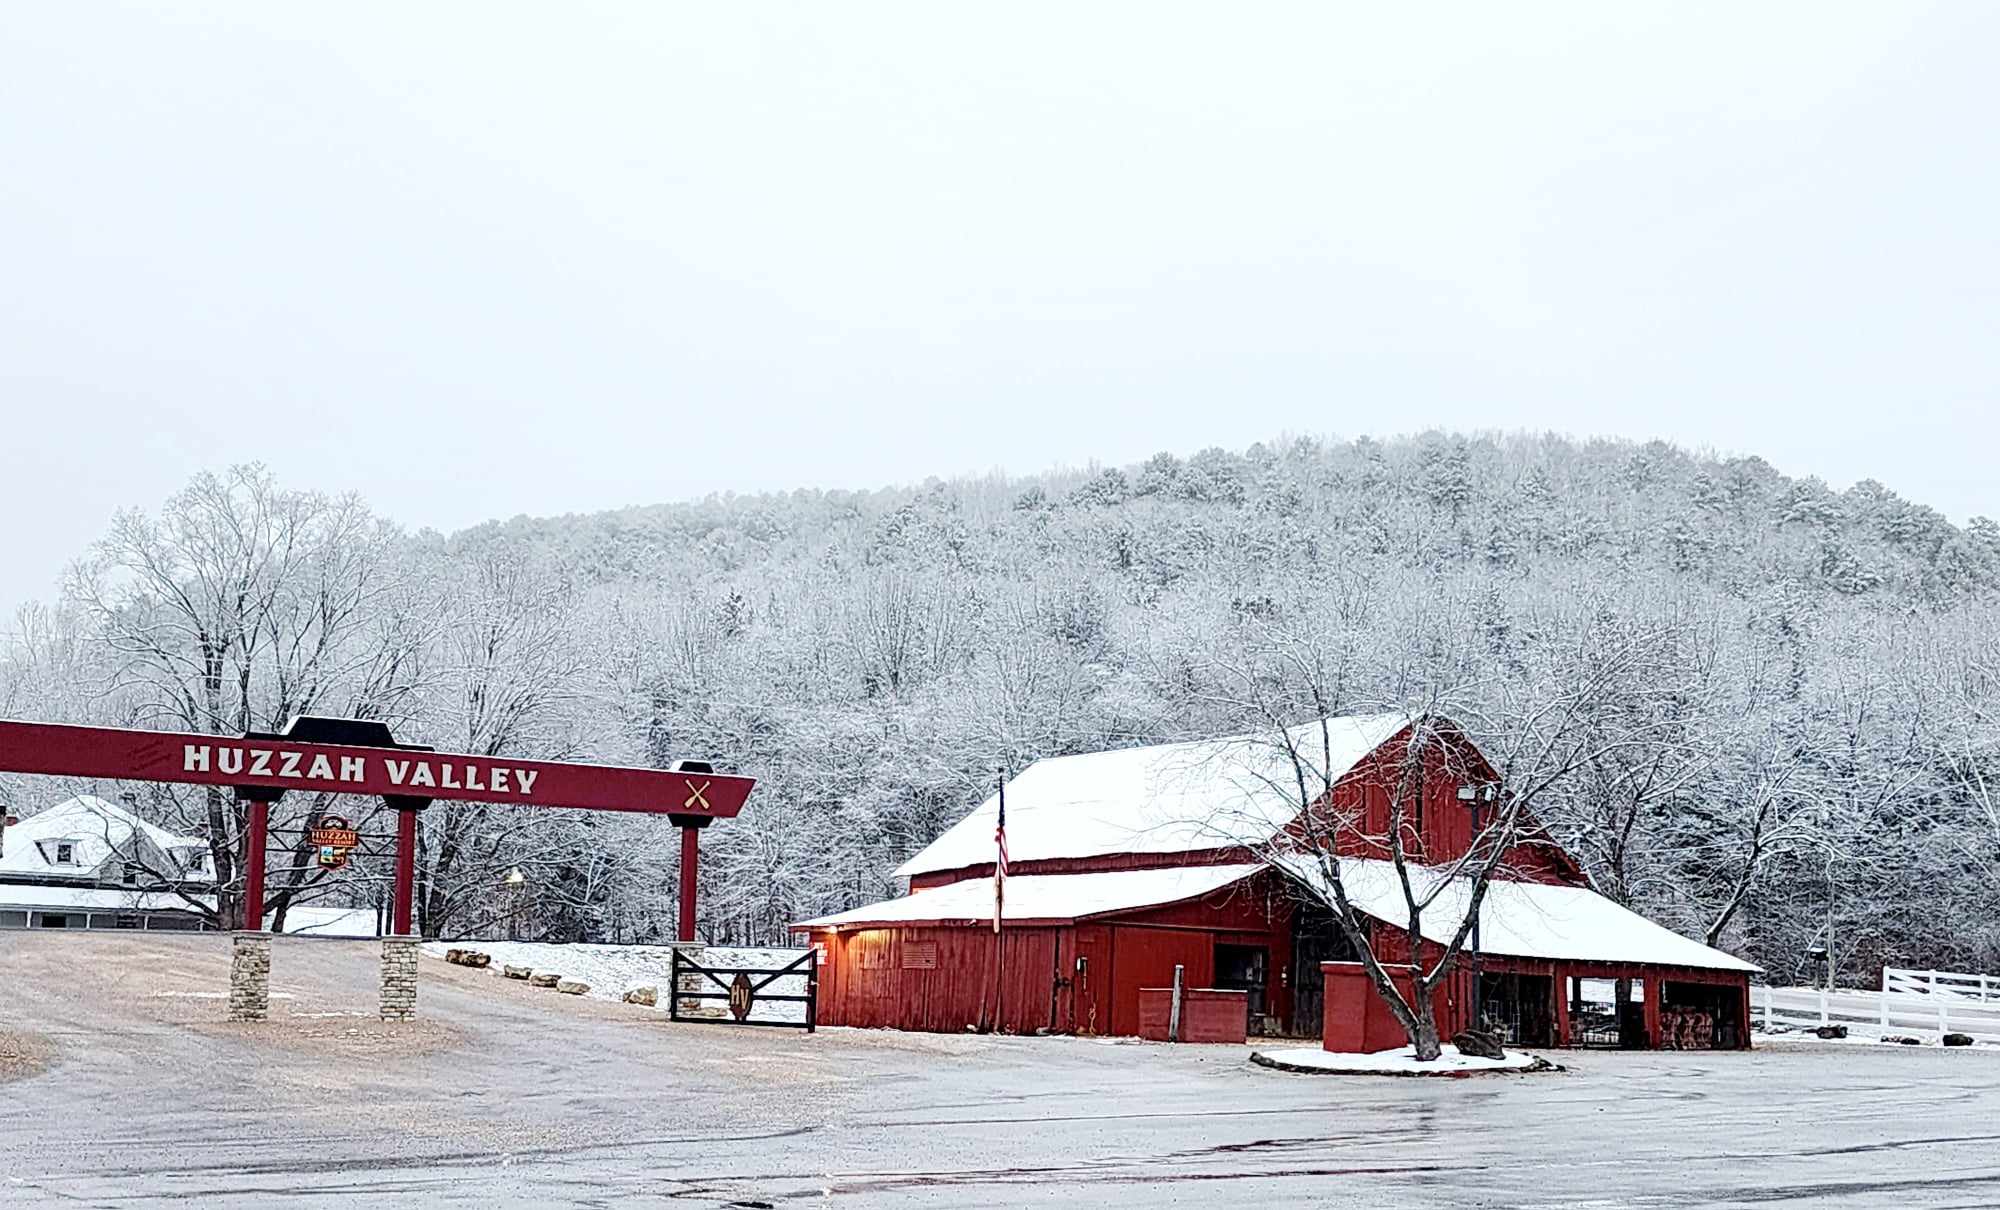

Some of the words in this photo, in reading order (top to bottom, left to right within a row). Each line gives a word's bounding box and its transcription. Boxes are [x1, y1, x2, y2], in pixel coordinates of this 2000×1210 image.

[183, 744, 365, 782] HUZZAH
[384, 759, 538, 794] VALLEY
[311, 831, 356, 841] HUZZAH
[731, 984, 749, 1009] HV
